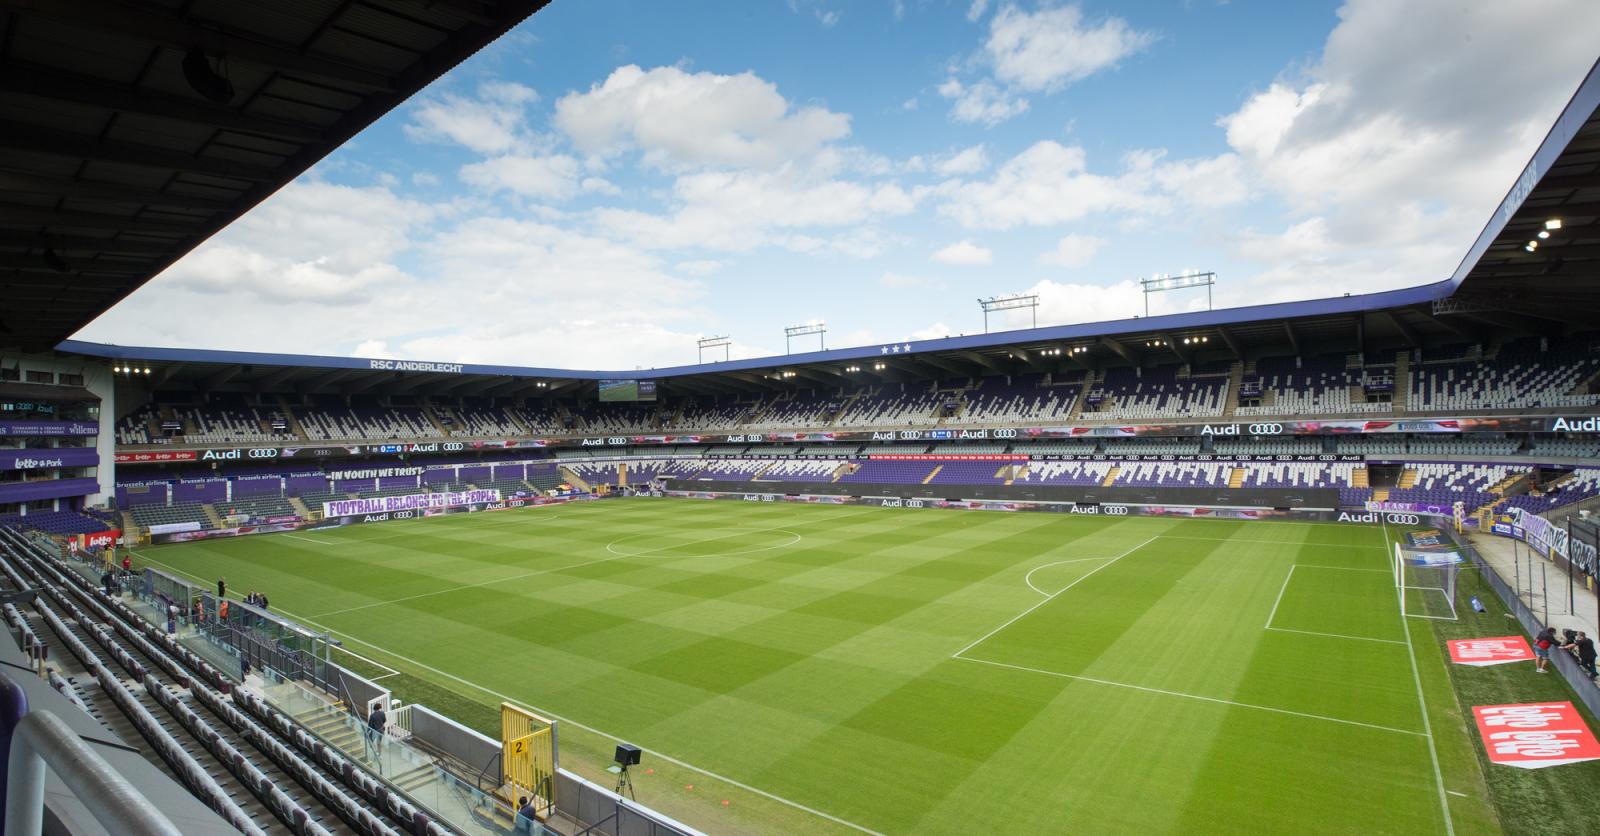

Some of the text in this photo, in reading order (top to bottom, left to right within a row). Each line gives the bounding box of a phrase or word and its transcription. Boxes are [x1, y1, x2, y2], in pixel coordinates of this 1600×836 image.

[370, 359, 464, 373] RSC ANDERLECHT
[1552, 417, 1600, 431] Audi
[961, 429, 988, 438] Audi
[1201, 424, 1240, 435] Audi
[872, 431, 896, 440] Audi
[582, 437, 605, 446] Audi
[412, 442, 438, 452] Audi
[202, 448, 241, 460] Audi
[46, 458, 63, 467] Park
[331, 471, 343, 480] IN
[344, 469, 377, 480] YOUTH
[378, 467, 393, 478] WE
[394, 466, 422, 477] TRUST
[329, 499, 384, 516] FOOTBALL
[386, 494, 430, 511] BELONGS
[432, 494, 444, 506] TO
[465, 489, 497, 504] PEOPLE
[881, 499, 902, 508] Audi
[1071, 505, 1098, 515] Audi
[363, 513, 389, 522] Audi
[1338, 512, 1378, 523] Audi
[516, 742, 522, 752] 2
